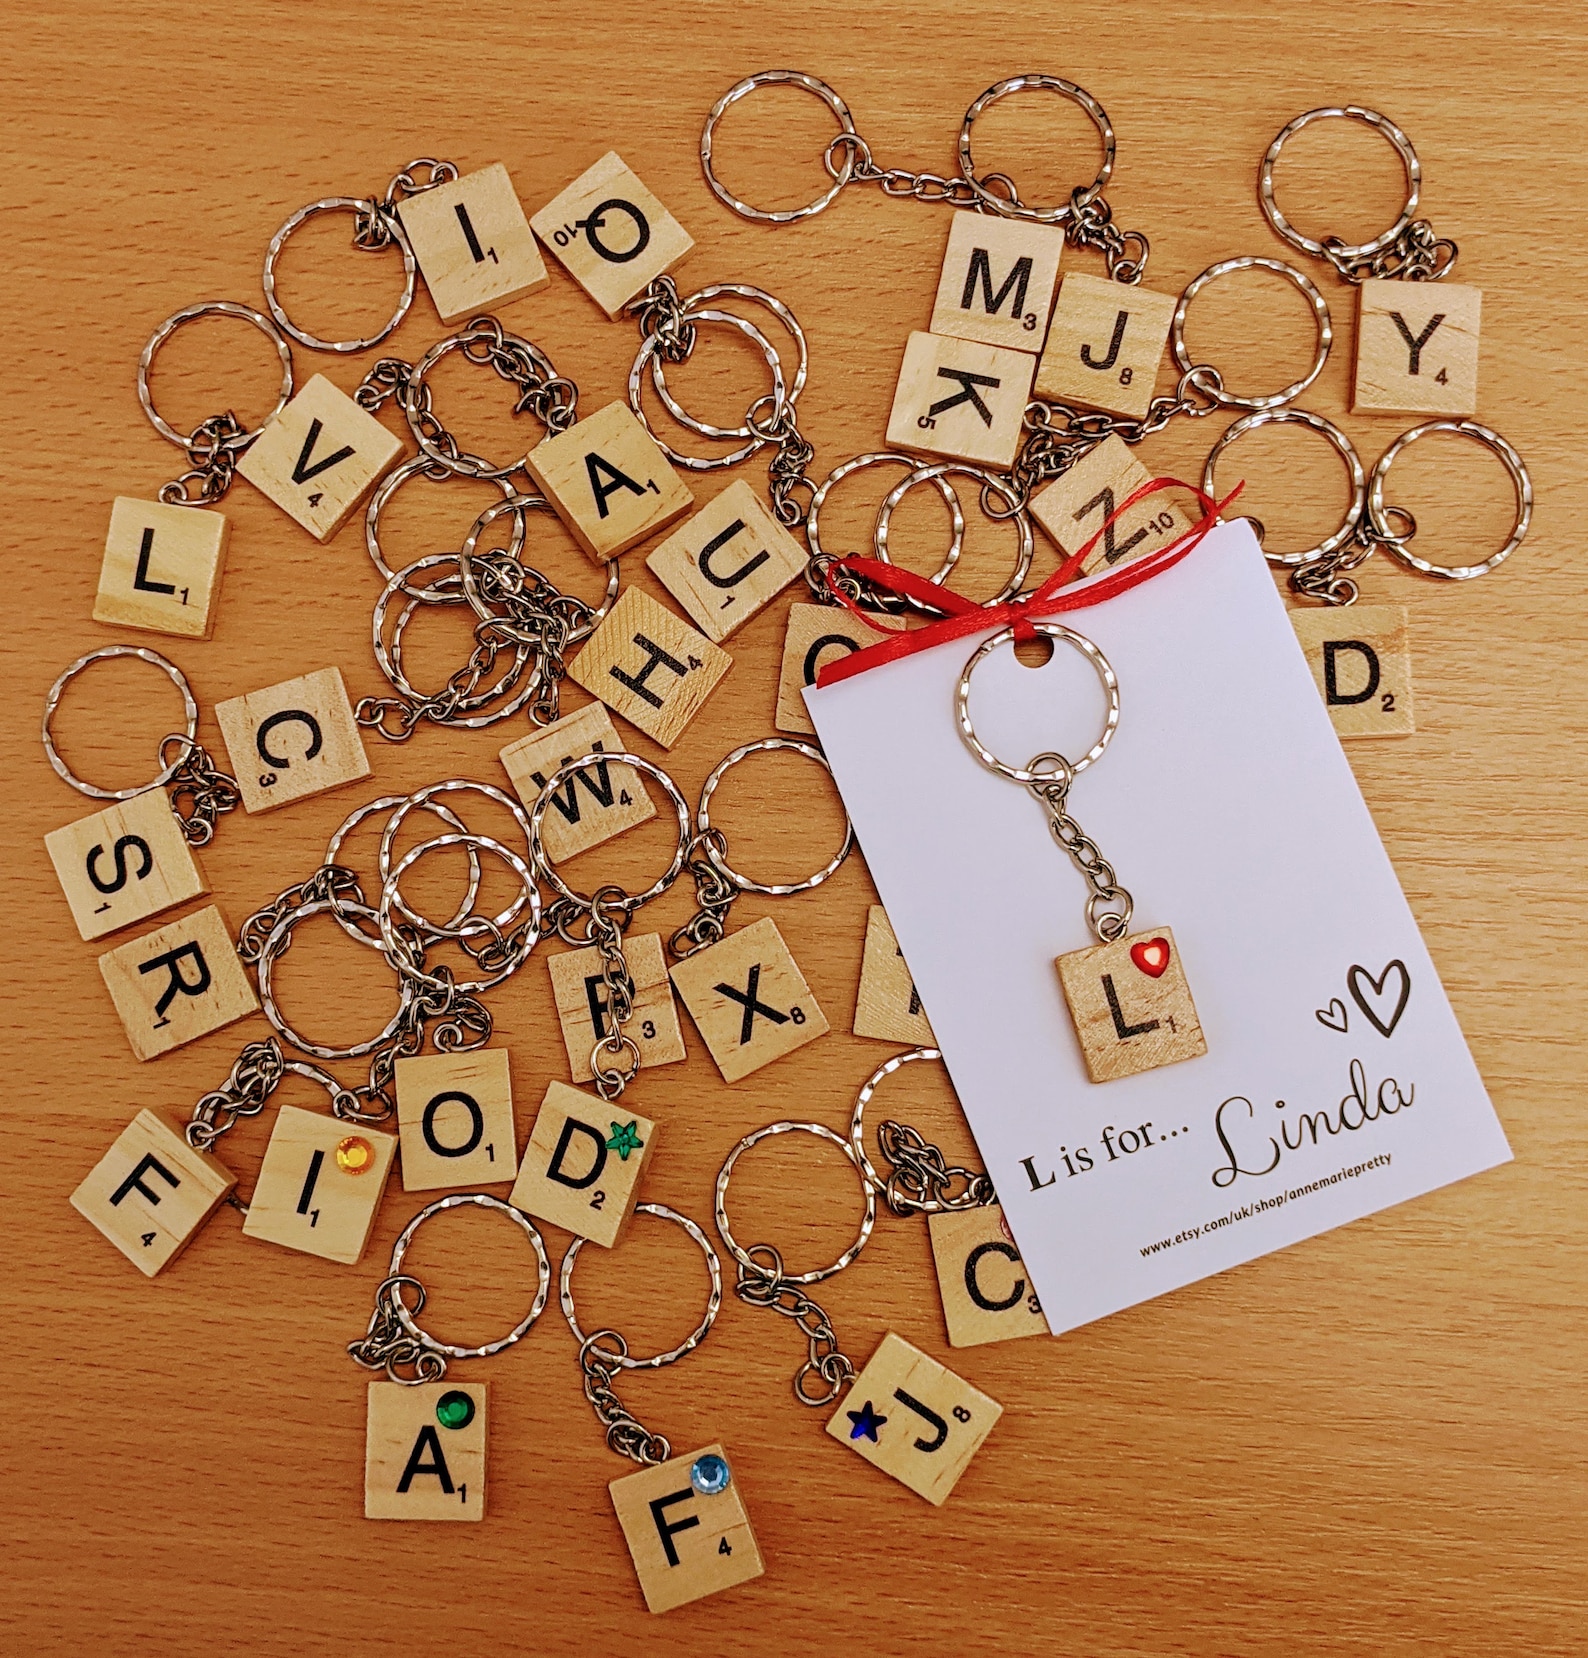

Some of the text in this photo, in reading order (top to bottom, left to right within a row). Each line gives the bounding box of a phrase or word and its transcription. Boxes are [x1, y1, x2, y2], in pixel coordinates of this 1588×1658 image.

[455, 203, 499, 265] I 1
[553, 198, 650, 263] Q 10
[960, 247, 1037, 331] M 3
[1081, 311, 1133, 386] J 8
[1390, 312, 1449, 386] Y 4
[917, 366, 1001, 430] K 5
[292, 418, 355, 508] V 4
[585, 452, 661, 519] A 1
[699, 519, 770, 610] U 1
[1072, 487, 1175, 565] Z 10
[134, 528, 189, 606] L 1
[608, 632, 704, 709] H 4
[1324, 640, 1396, 713] D 2
[257, 710, 322, 788] C 3
[529, 740, 633, 825] W 4
[87, 835, 152, 914] S 1
[138, 941, 211, 1030] R 1
[713, 963, 806, 1045] X 8
[1102, 974, 1178, 1039] L 1
[641, 1020, 656, 1040] 3
[422, 1091, 495, 1162] O 1
[546, 1116, 608, 1211] D 2
[1019, 1155, 1056, 1191] L
[1060, 1145, 1094, 1178] is
[1211, 1058, 1415, 1188] Linda
[110, 1153, 180, 1248] F 4
[297, 1150, 324, 1228] I 1
[1139, 1151, 1393, 1258] www.etsy.com/uk/shop/annemariepretty
[964, 1242, 1025, 1311] C
[894, 1388, 972, 1452] J 8
[397, 1426, 467, 1504] A 1
[649, 1487, 733, 1567] F 4
